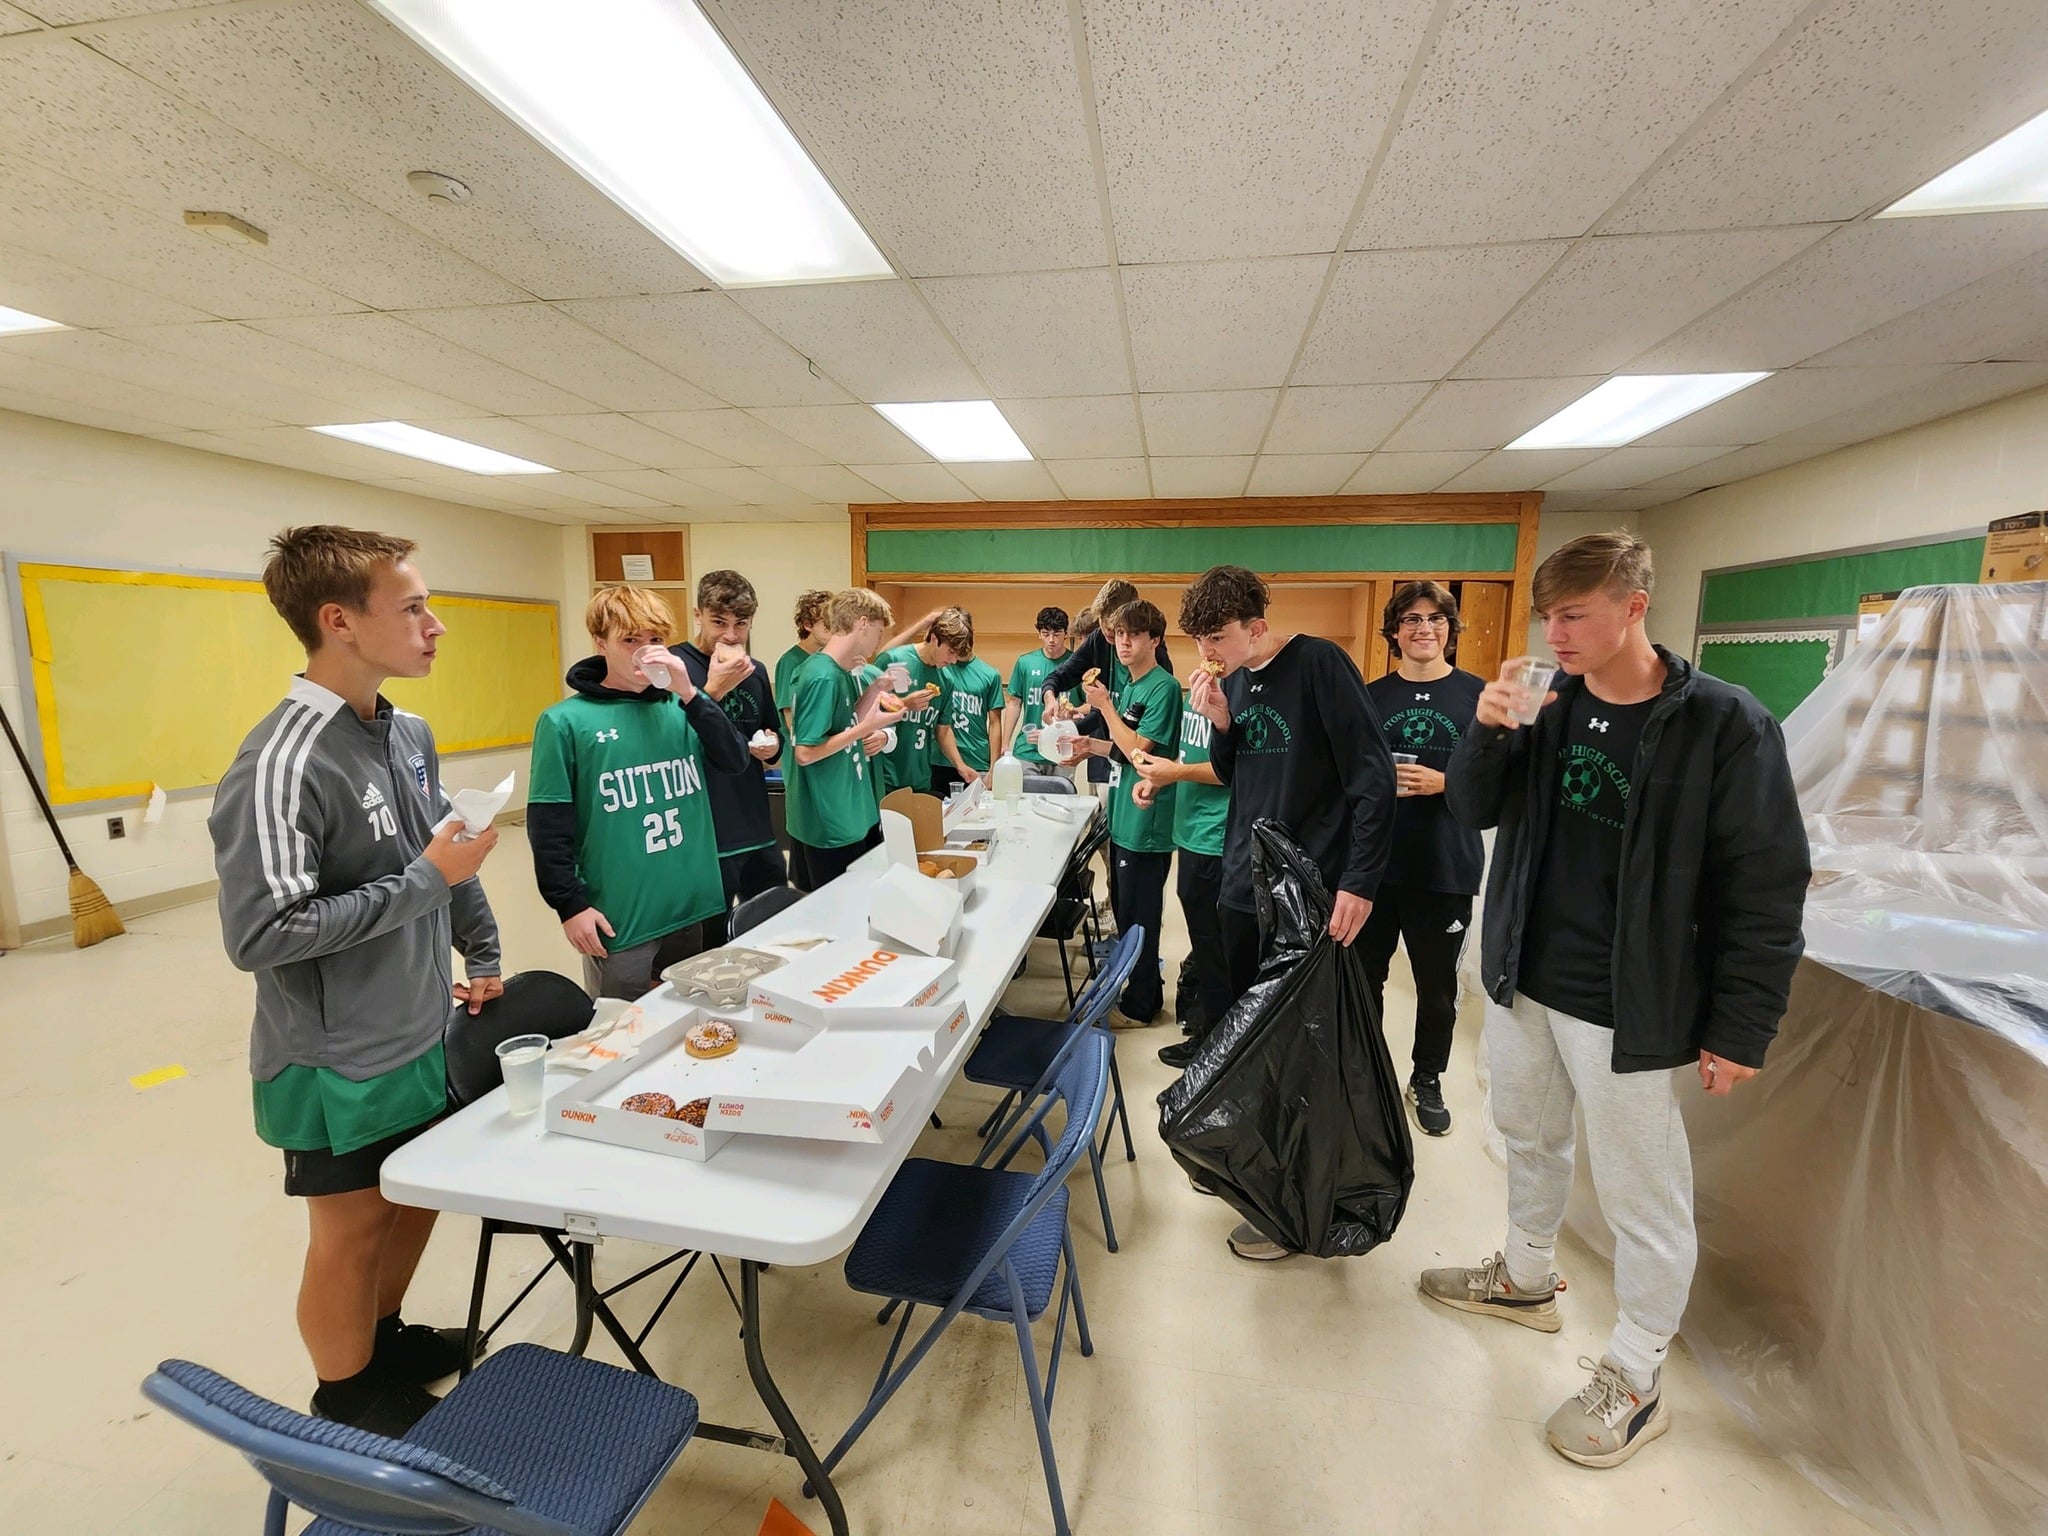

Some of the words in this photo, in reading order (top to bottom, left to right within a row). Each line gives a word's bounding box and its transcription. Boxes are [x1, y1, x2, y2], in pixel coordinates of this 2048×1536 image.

[1264, 706, 1292, 745] SCHOOL
[1406, 707, 1434, 717] HIGH
[914, 728, 927, 750] 3
[1571, 744, 1607, 766] HIGH
[598, 753, 702, 813] SUTTON
[368, 804, 397, 842] 10
[642, 807, 684, 854] 25
